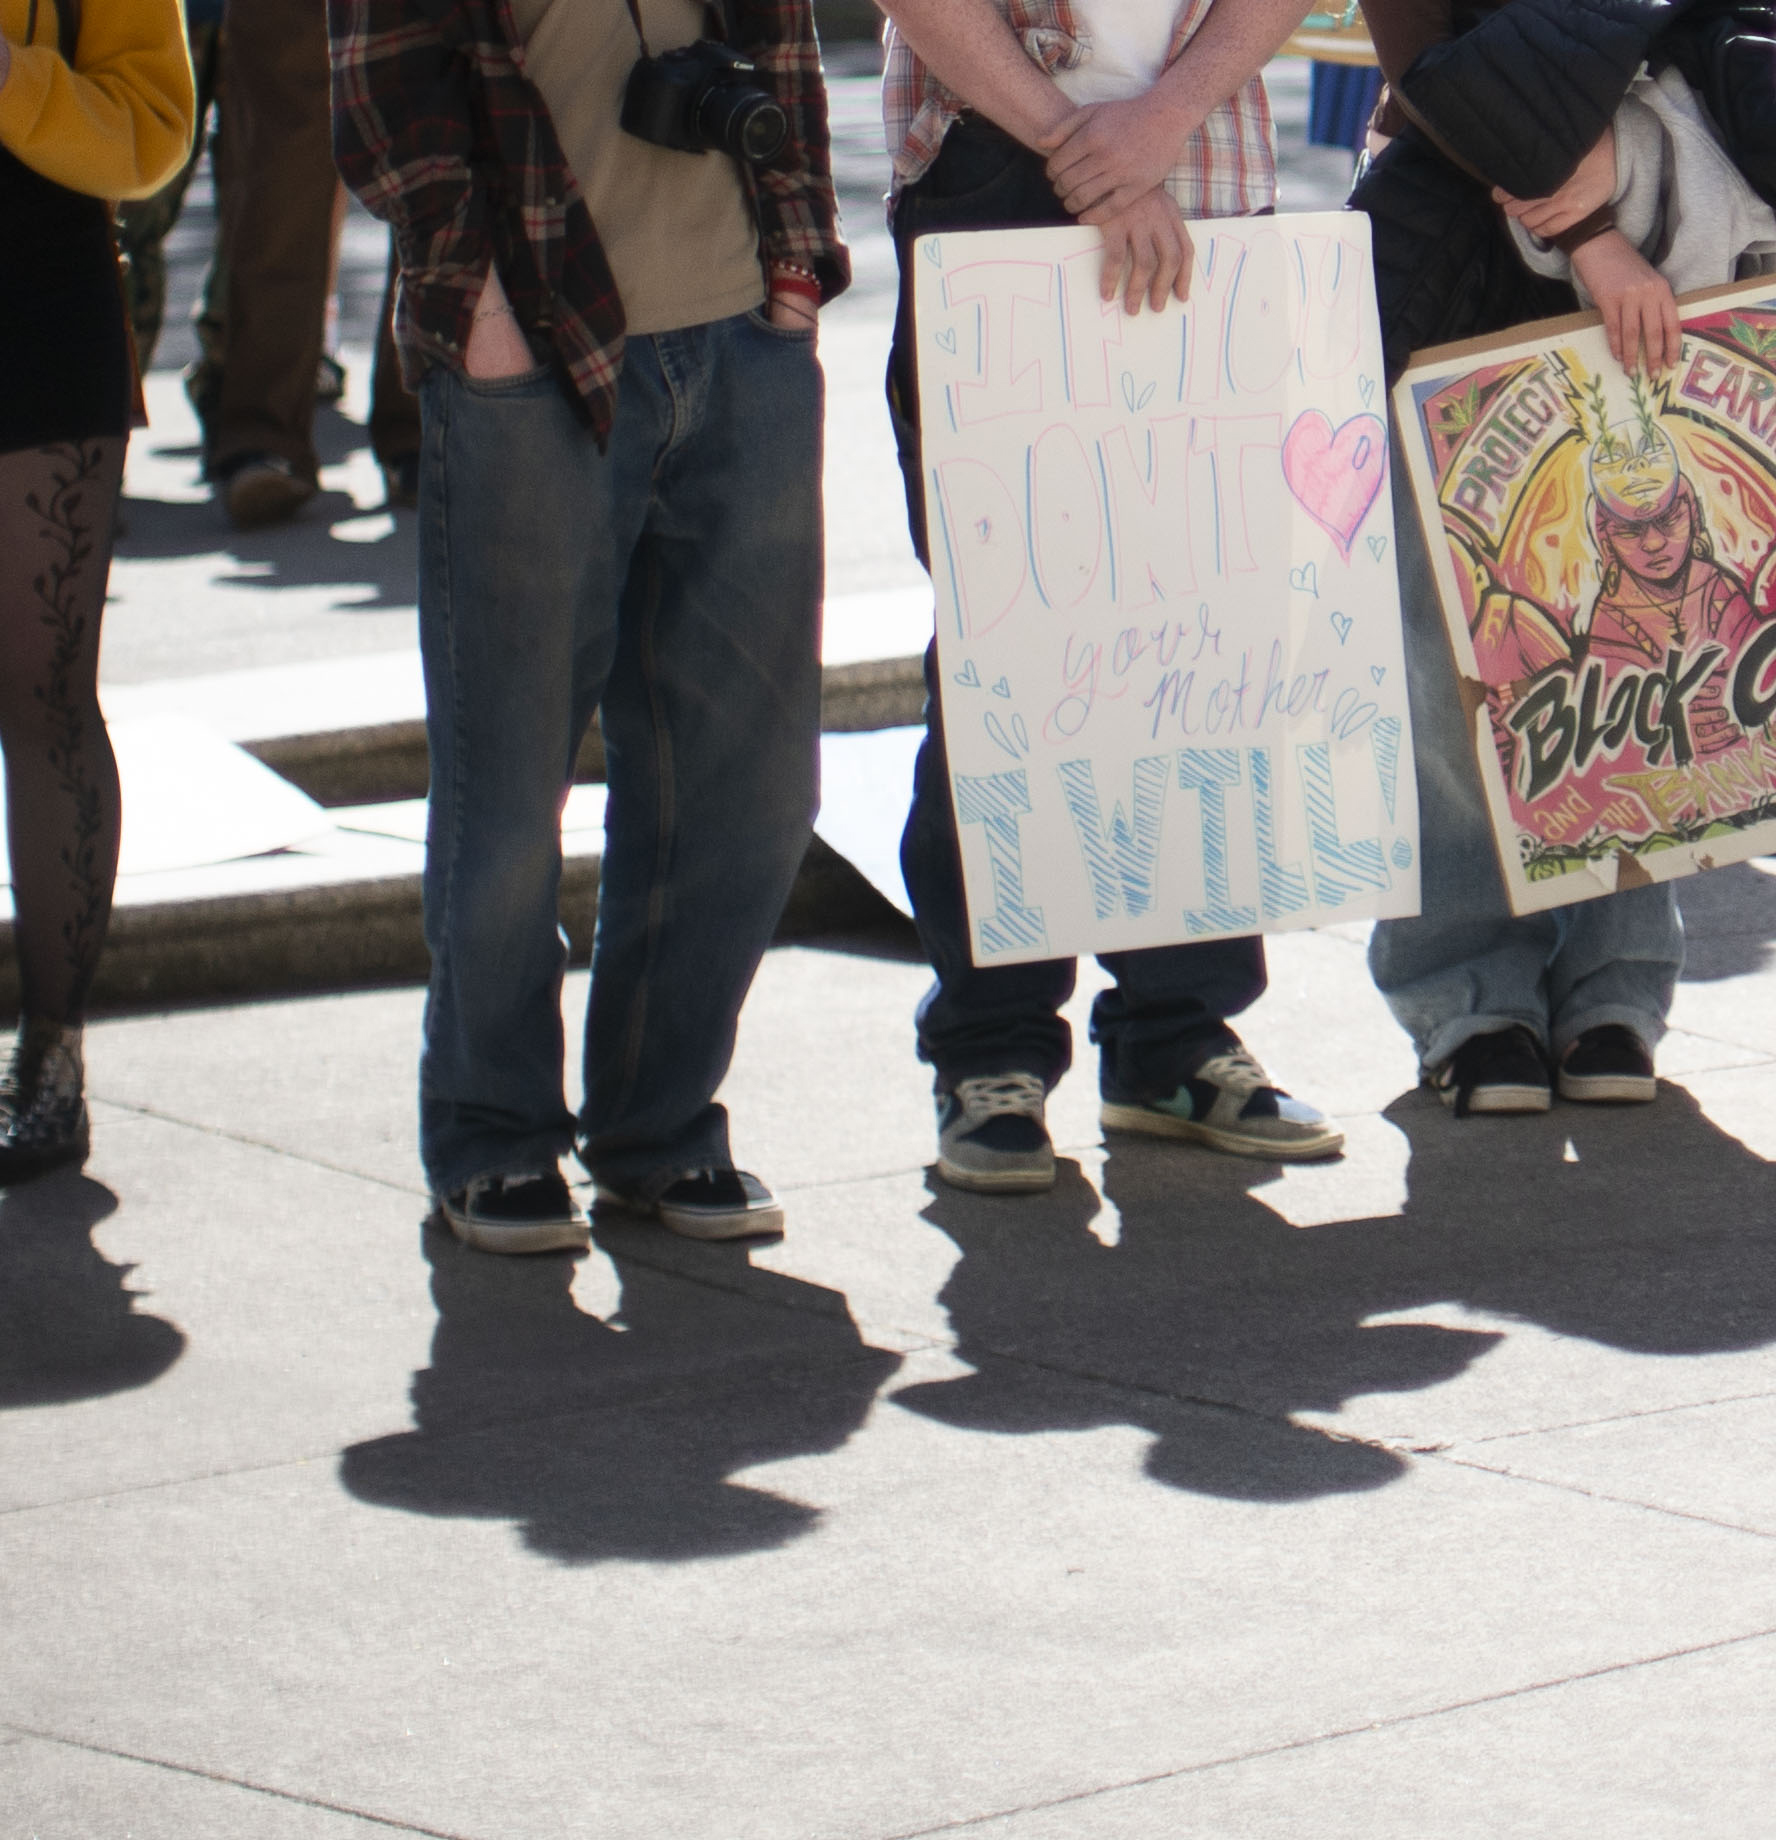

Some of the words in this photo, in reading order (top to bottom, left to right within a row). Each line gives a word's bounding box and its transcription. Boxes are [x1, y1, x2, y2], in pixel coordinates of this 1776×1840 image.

[1178, 229, 1366, 410] YOU
[1453, 365, 1566, 533] PROTECT
[954, 768, 1050, 956] I
[1056, 715, 1414, 936] WILL!
[1599, 797, 1641, 829] THE
